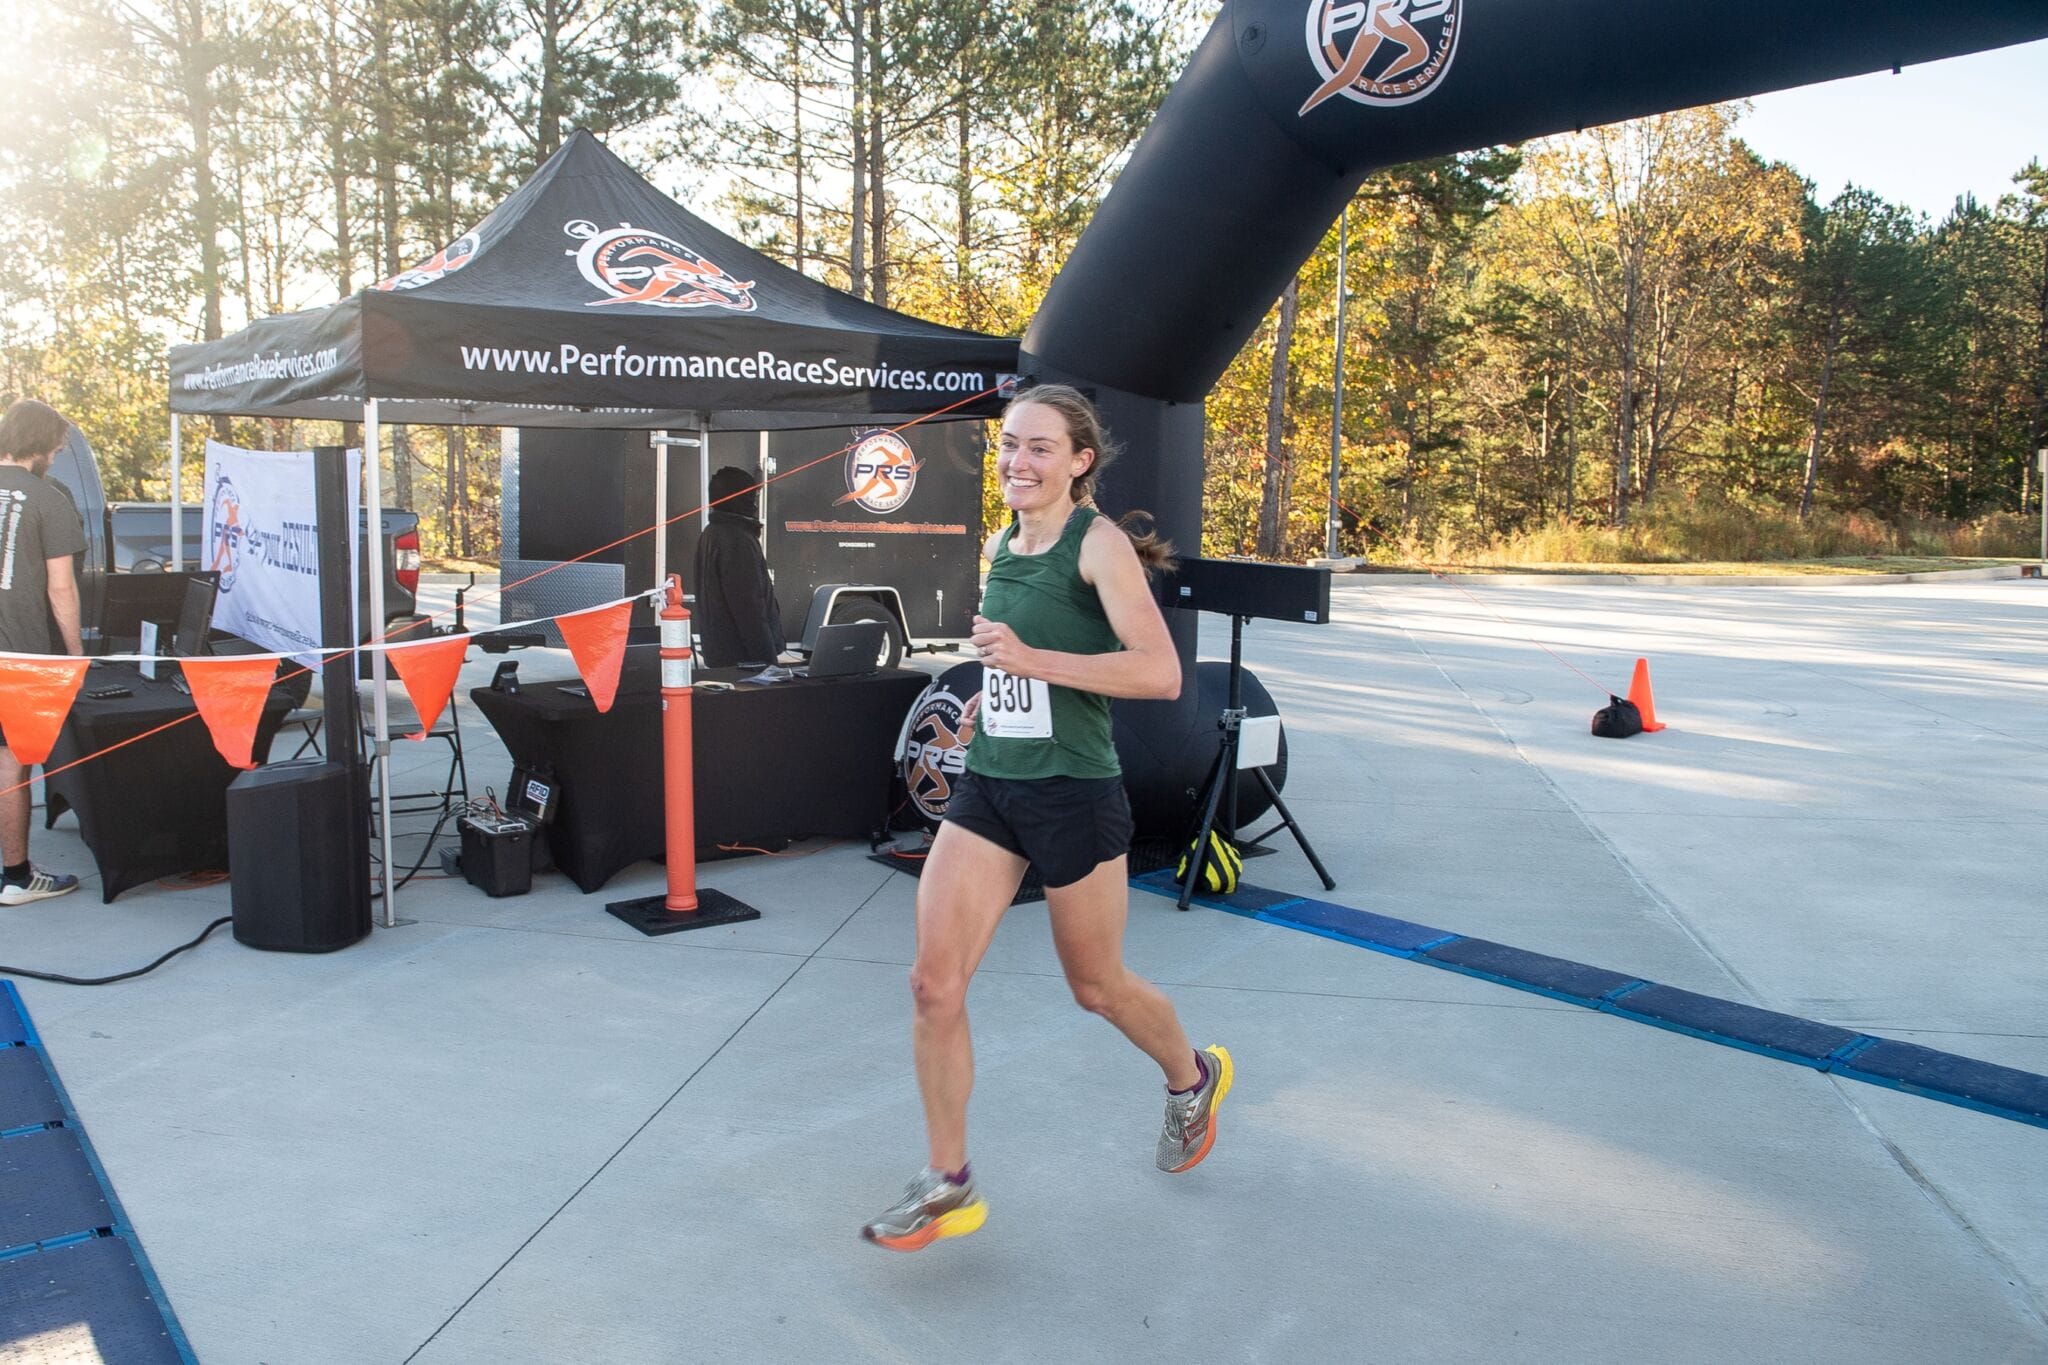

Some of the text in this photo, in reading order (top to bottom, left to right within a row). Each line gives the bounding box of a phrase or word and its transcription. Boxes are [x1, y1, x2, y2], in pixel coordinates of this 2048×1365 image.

[1358, 13, 1455, 95] RACE SERVICES
[599, 237, 693, 267] PERFORMANCE
[183, 347, 338, 392] www.PerformanceRaceServices.com
[461, 344, 985, 393] www.PerformanceRaceServices.com
[854, 464, 911, 480] PRS
[989, 673, 1032, 714] 930
[908, 740, 967, 774] PRS
[530, 782, 548, 797] RFID
